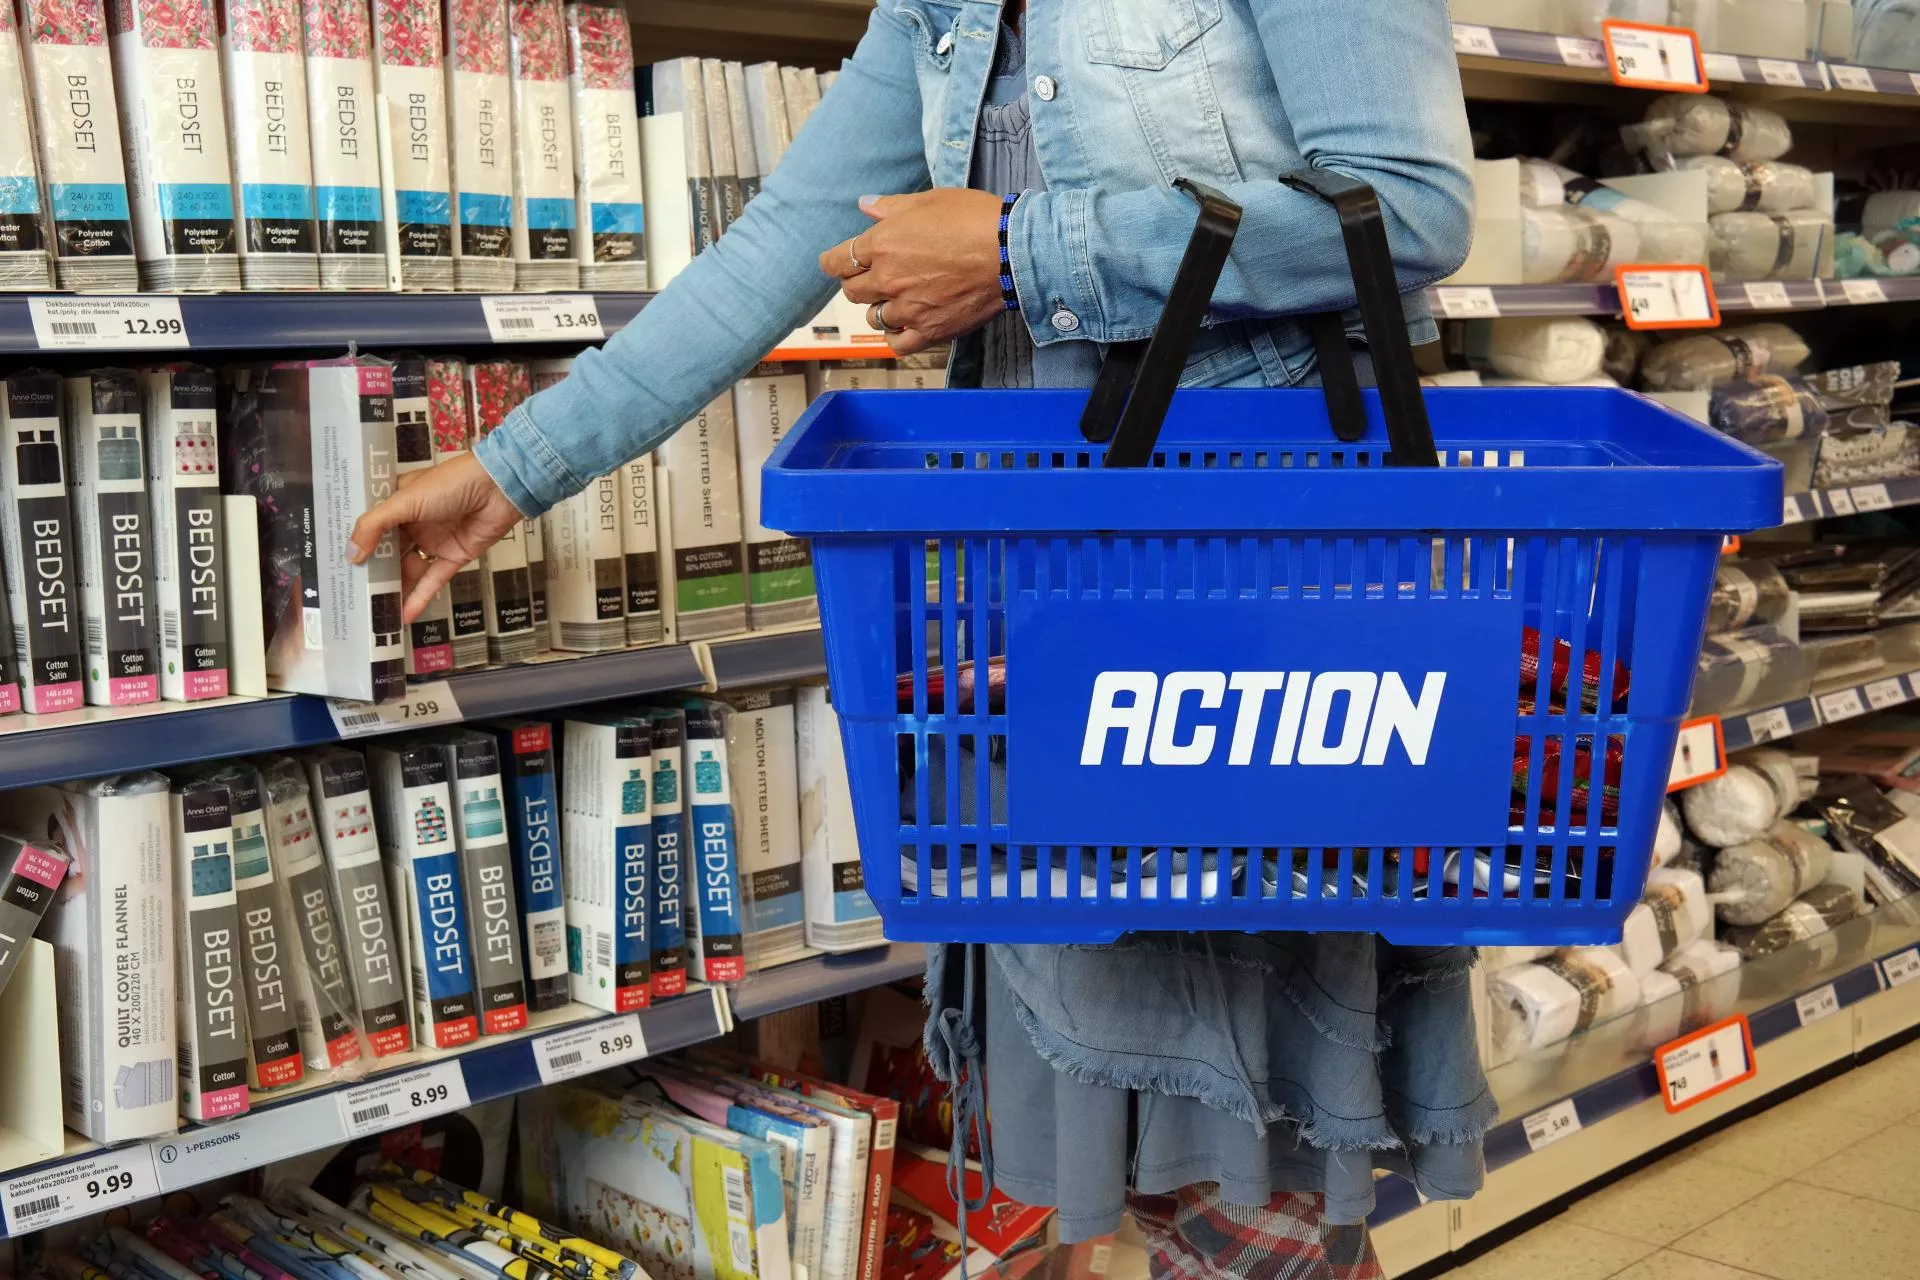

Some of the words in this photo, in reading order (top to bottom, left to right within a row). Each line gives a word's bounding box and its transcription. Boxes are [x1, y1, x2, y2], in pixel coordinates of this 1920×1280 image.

[68, 74, 96, 154] BEDSET
[177, 78, 203, 155] BEDSET
[264, 80, 288, 156] BEDSET
[337, 85, 359, 159] BEDSET
[408, 92, 429, 164] BEDSET
[480, 99, 495, 168] BEDSET
[541, 106, 559, 173] BEDSET
[606, 112, 625, 179] BEDSET
[70, 191, 88, 201] 240
[96, 191, 113, 201] 200
[78, 228, 114, 240] Polyester
[84, 237, 111, 248] Cotton
[184, 227, 219, 239] Polyester
[190, 236, 216, 247] Cotton
[266, 227, 300, 238] Polyester
[271, 236, 297, 246] Cotton
[46, 301, 111, 310] Dekbedovertrekset
[124, 319, 182, 336] 12.99
[554, 313, 598, 328] 13.49
[768, 383, 780, 435] MOLTON
[700, 441, 712, 480] FITTED
[369, 443, 395, 565] BSET
[599, 479, 615, 533] EDSET
[631, 464, 648, 528] BEDSET
[703, 484, 714, 530] SHEET
[302, 507, 312, 535] Cotton
[303, 539, 313, 559] Poly
[33, 518, 68, 634] BEDSET
[112, 513, 146, 628] BEDSET
[188, 507, 218, 621] BEDSET
[455, 609, 481, 622] Polyester
[459, 618, 480, 631] Cotton
[500, 607, 529, 620] Polyester
[505, 617, 527, 628] Cotton
[425, 624, 438, 636] Poly
[46, 660, 69, 671] Cotton
[121, 654, 145, 666] Cotton
[195, 646, 217, 659] Cotton
[198, 657, 215, 669] Satin
[50, 671, 67, 682] Satin
[124, 663, 143, 674] Satin
[399, 700, 439, 718] 7.99
[1080, 670, 1448, 766] ACTION
[755, 716, 768, 769] MOLTON
[758, 772, 769, 811] FITTED
[525, 795, 554, 895] BEDSET
[759, 815, 770, 855] SHEET
[658, 832, 681, 929] BEDSET
[702, 821, 733, 918] BEDSET
[16, 885, 40, 903] Cotton
[624, 843, 645, 943] BEDSET
[114, 884, 129, 949] FLANNEL
[427, 873, 464, 975] BEDSET
[479, 865, 514, 965] BEDSET
[302, 887, 343, 998] BEDSET
[352, 881, 393, 986] BEDSET
[713, 941, 732, 953] Cotton
[130, 952, 140, 970] CM
[245, 906, 286, 1014] BEDSET
[116, 953, 131, 1003] COVER
[203, 928, 236, 1042] BEDSET
[130, 973, 142, 1012] 200/220
[494, 991, 515, 1003] Cotton
[131, 1015, 141, 1025] X
[375, 1011, 397, 1024] Cotton
[443, 1002, 465, 1015] Cotton
[117, 1007, 132, 1049] QUILT
[131, 1027, 142, 1046] 140
[267, 1040, 290, 1055] Cotton
[600, 1034, 634, 1055] 8.99
[213, 1070, 236, 1083] Cotton
[347, 1080, 401, 1099] Dekbedovertrekset
[410, 1085, 449, 1107] 8.99
[185, 1132, 242, 1154] 1-PERSOONS
[9, 1166, 76, 1192] Dekbedovertrekset
[76, 1161, 97, 1175] flanel
[10, 1186, 36, 1200] katoen
[37, 1174, 80, 1195] 140x200/220
[87, 1171, 134, 1199] 9.99
[803, 1152, 817, 1201] FROZEN
[872, 1173, 882, 1208] SLOOP
